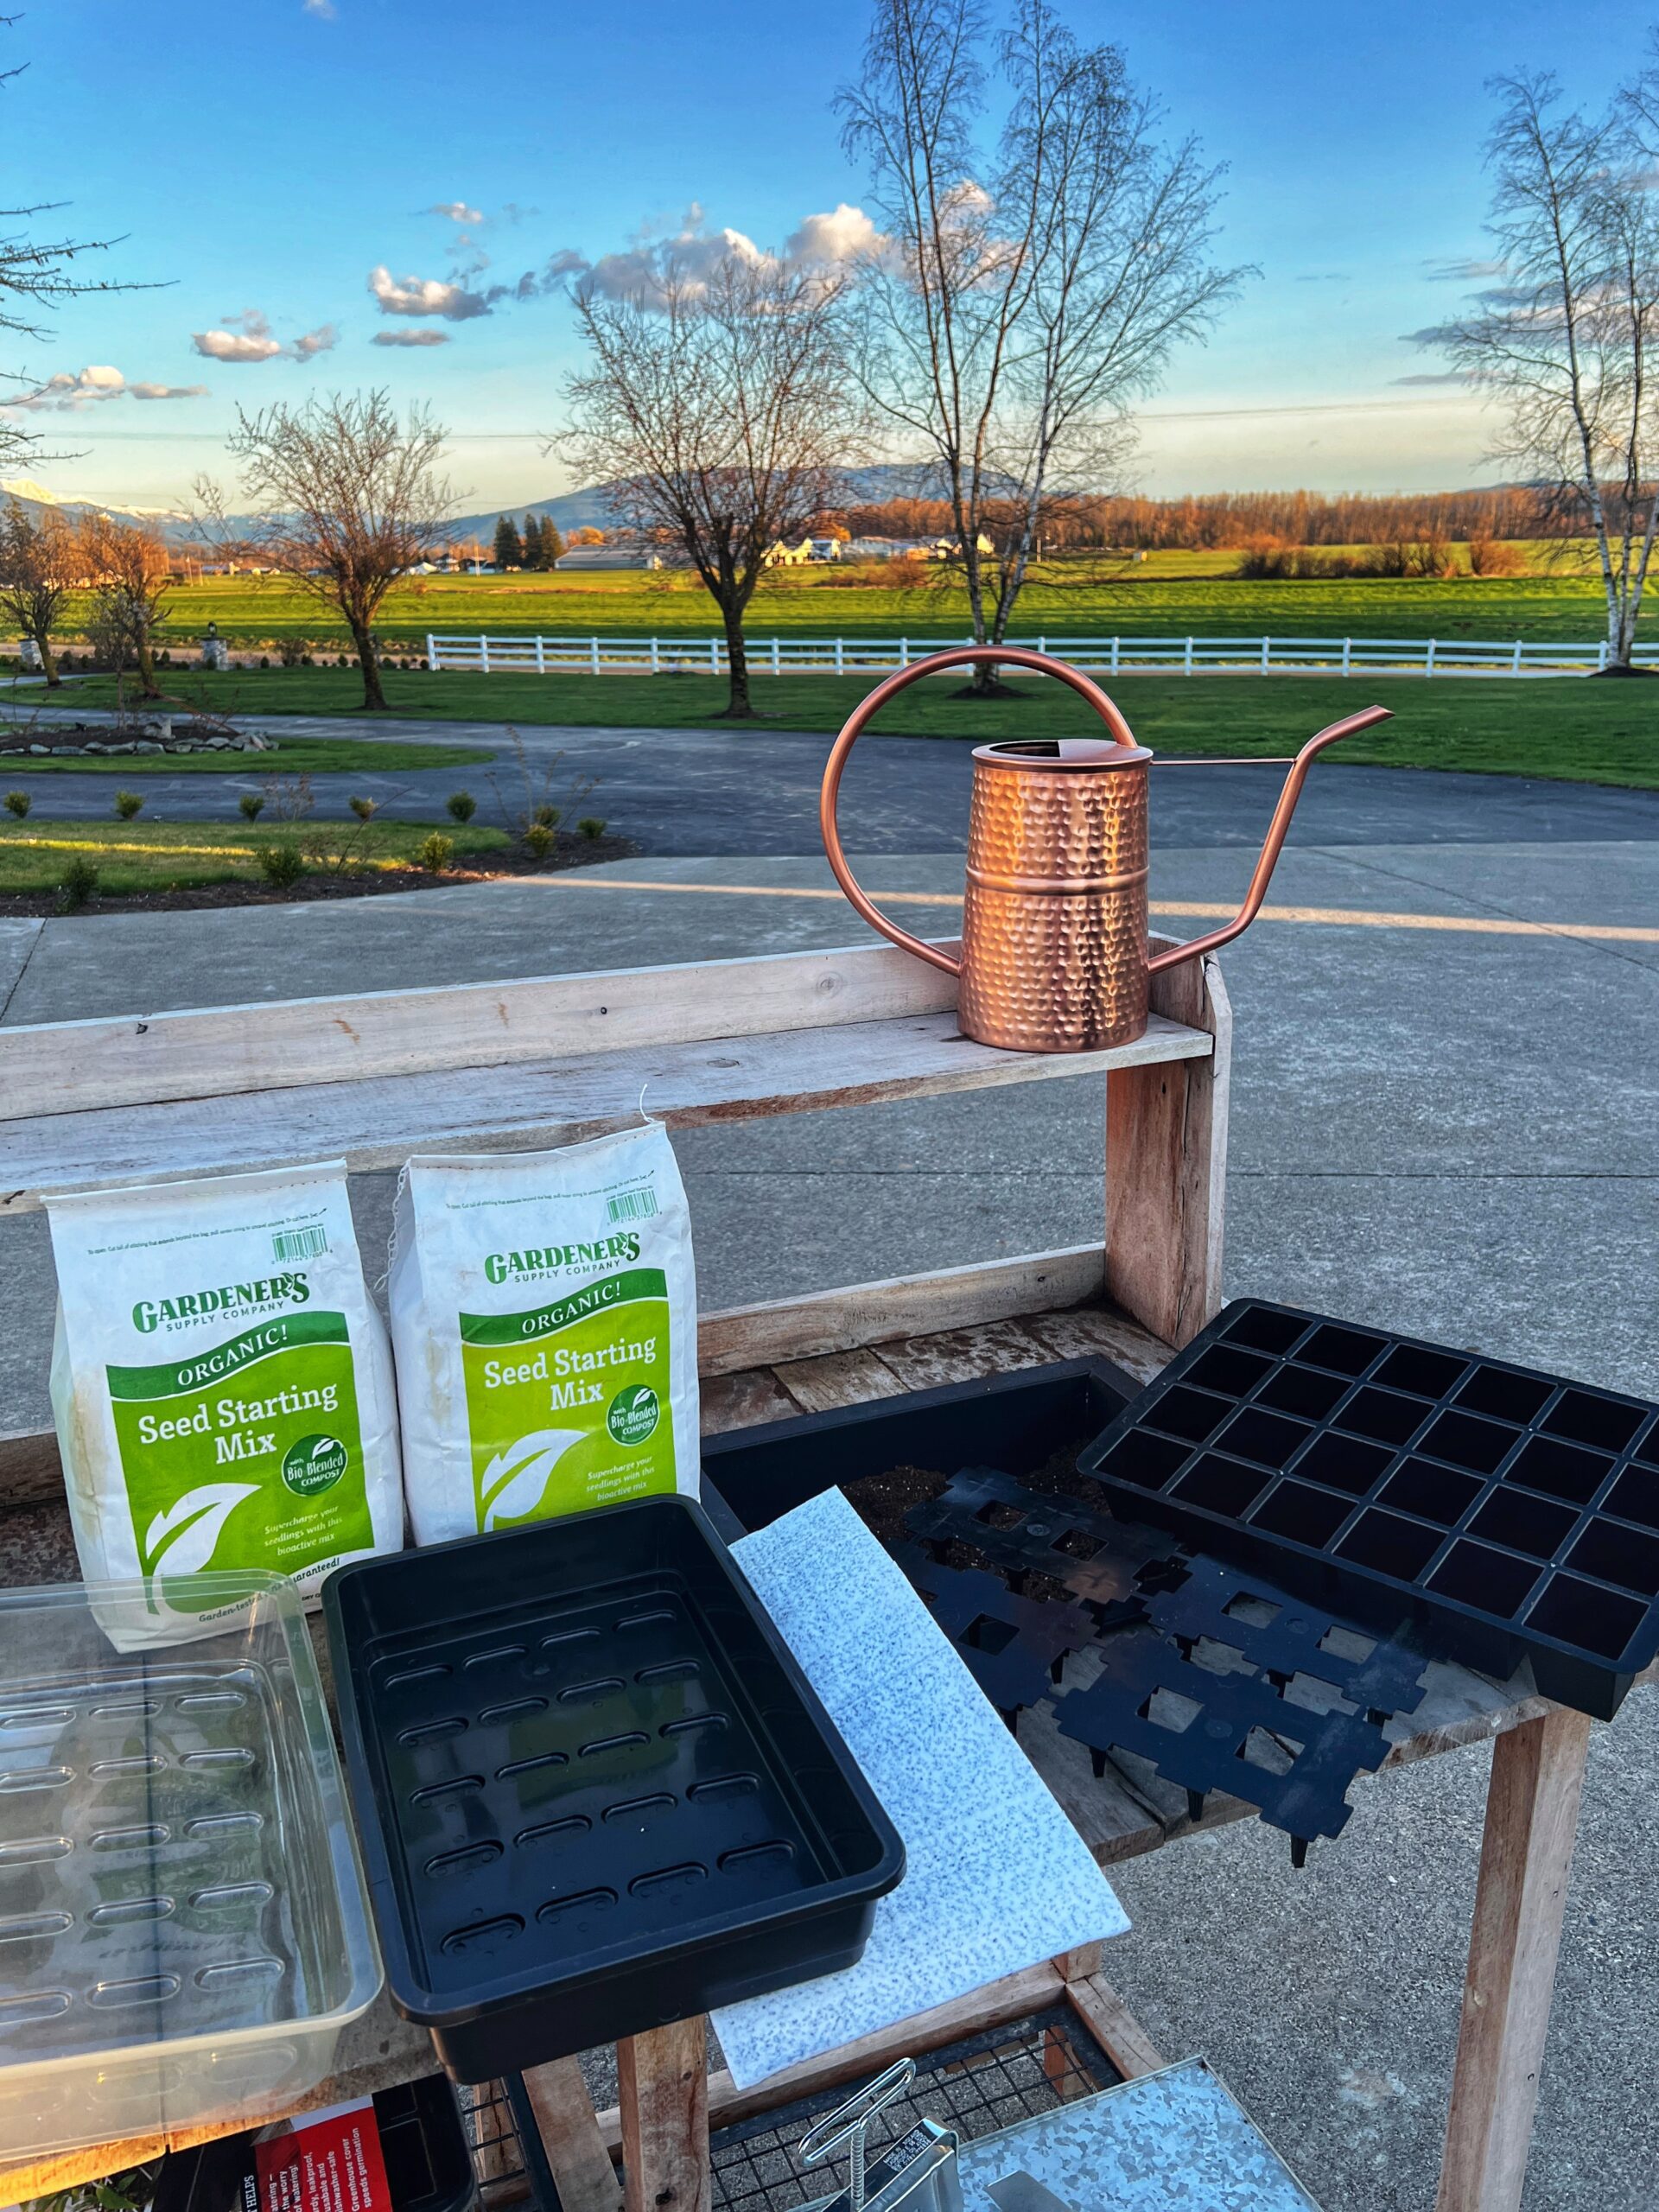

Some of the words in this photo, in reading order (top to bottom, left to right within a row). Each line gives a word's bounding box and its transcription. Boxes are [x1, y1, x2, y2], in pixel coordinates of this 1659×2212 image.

[514, 1269, 559, 1282] SUPPLY
[566, 1259, 620, 1275] COMPANY
[166, 1314, 216, 1332] SUPPLY
[223, 1300, 284, 1320] COMPANY
[522, 1281, 620, 1334] ORGANIC!
[177, 1324, 288, 1386] ORGANIC!
[484, 1351, 549, 1389] Seed
[554, 1336, 657, 1376] Starting
[550, 1379, 604, 1411] Mix
[138, 1403, 212, 1445] Seed
[217, 1383, 339, 1428] Starting
[622, 1419, 655, 1435] COMPOST
[214, 1429, 276, 1465] Mix
[301, 1468, 340, 1487] COMPOST
[586, 1477, 621, 1492] seedlings
[623, 1471, 640, 1483] with
[642, 1465, 655, 1477] this
[588, 1460, 635, 1480] Supercharge
[636, 1456, 652, 1468] your
[597, 1484, 632, 1501] bioactive
[632, 1482, 647, 1491] mix
[264, 1512, 319, 1535] Supercharge
[320, 1505, 339, 1518] your
[264, 1530, 304, 1547] seedlings
[306, 1522, 326, 1535] with
[327, 1516, 343, 1528] this
[276, 1538, 316, 1555] bioactive
[318, 1534, 335, 1543] mix
[342, 2138, 352, 2160] cover
[353, 2127, 368, 2176] germination
[280, 2171, 289, 2195] worry
[289, 2164, 301, 2203] watering!
[304, 2152, 316, 2194] leakproof,
[316, 2163, 327, 2179] and
[244, 2174, 257, 2209] HELPS
[346, 2162, 359, 2212] Greenhouse
[359, 2177, 372, 2209] speeds
[282, 2196, 290, 2210] the
